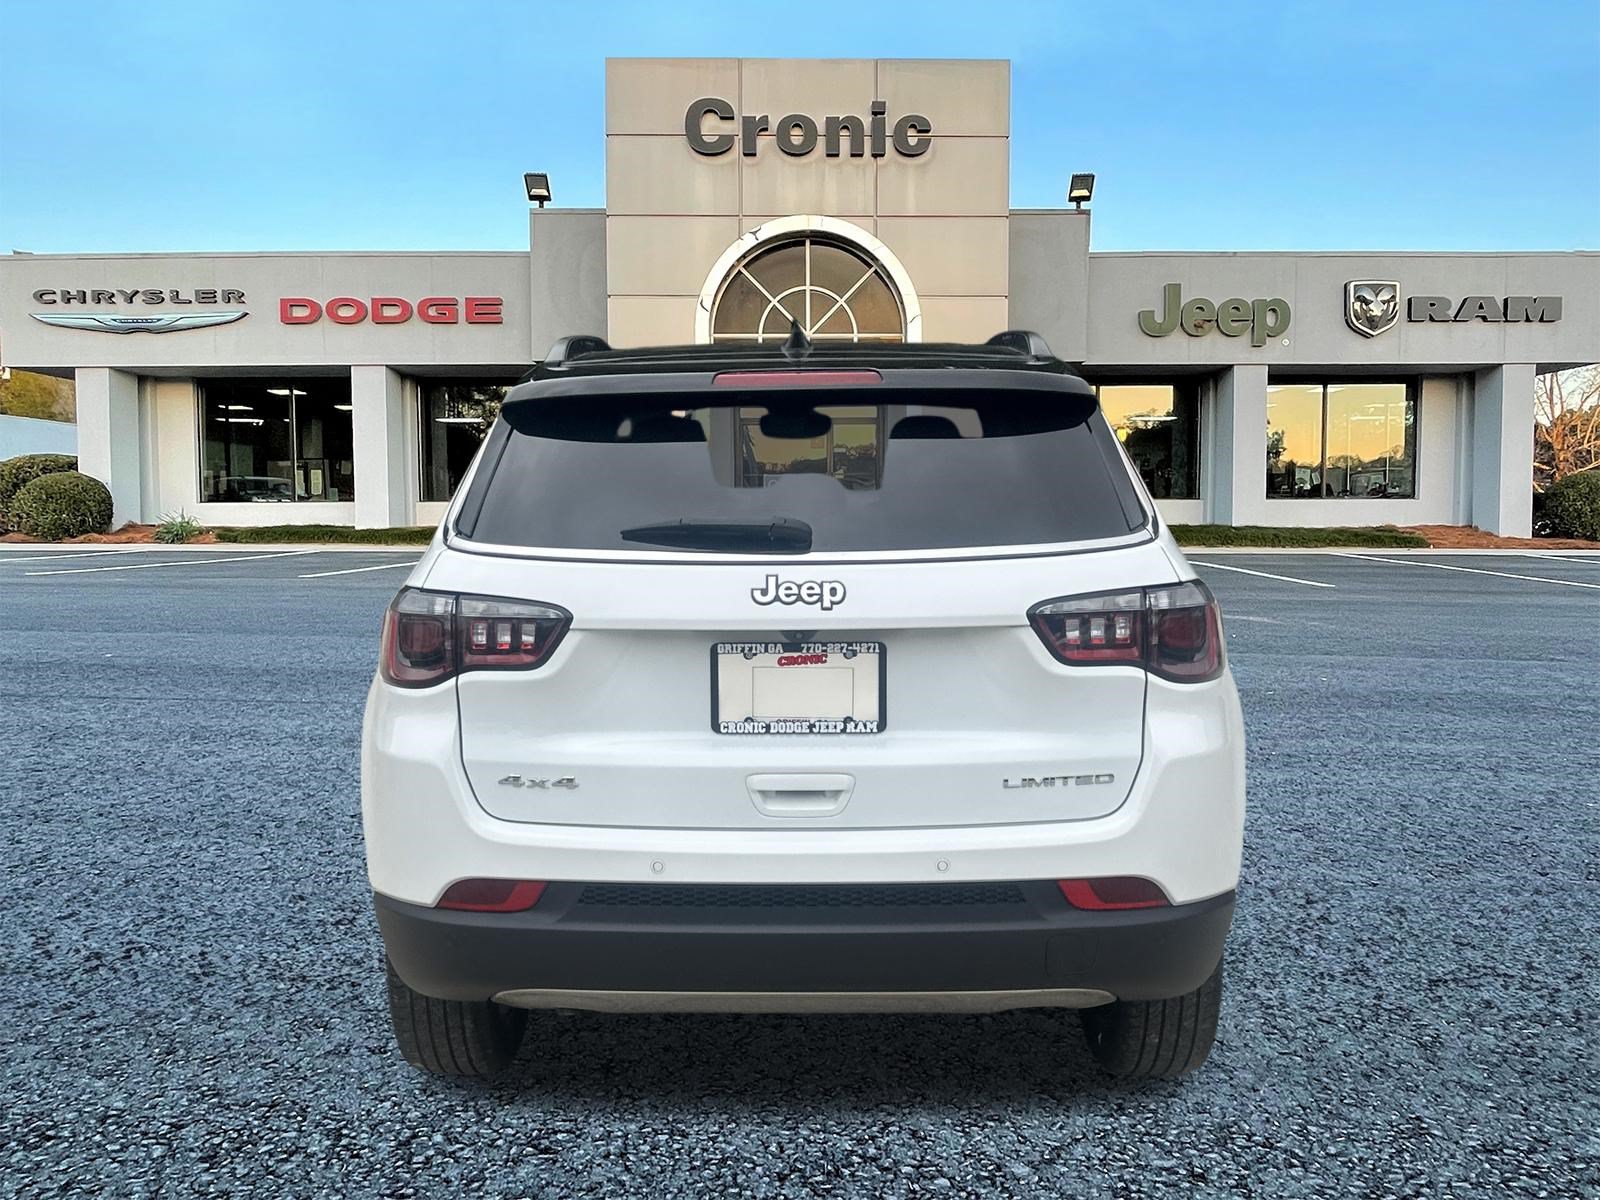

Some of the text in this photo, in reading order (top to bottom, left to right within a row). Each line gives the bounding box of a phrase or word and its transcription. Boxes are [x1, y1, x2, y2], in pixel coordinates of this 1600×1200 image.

[684, 97, 932, 157] Cronic
[32, 288, 246, 305] CHRYSLER
[280, 296, 503, 325] DODGE
[1138, 283, 1291, 347] Jeep
[1407, 295, 1562, 323] RAM
[751, 574, 846, 611] Jeep
[717, 642, 880, 654] GRIFFIN GA 770-227-4271
[777, 653, 828, 667] CRONIC
[720, 721, 878, 734] CRONIC DODGE JEEP RAM
[497, 774, 580, 791] 4x4
[1002, 773, 1115, 789] LIMITED
